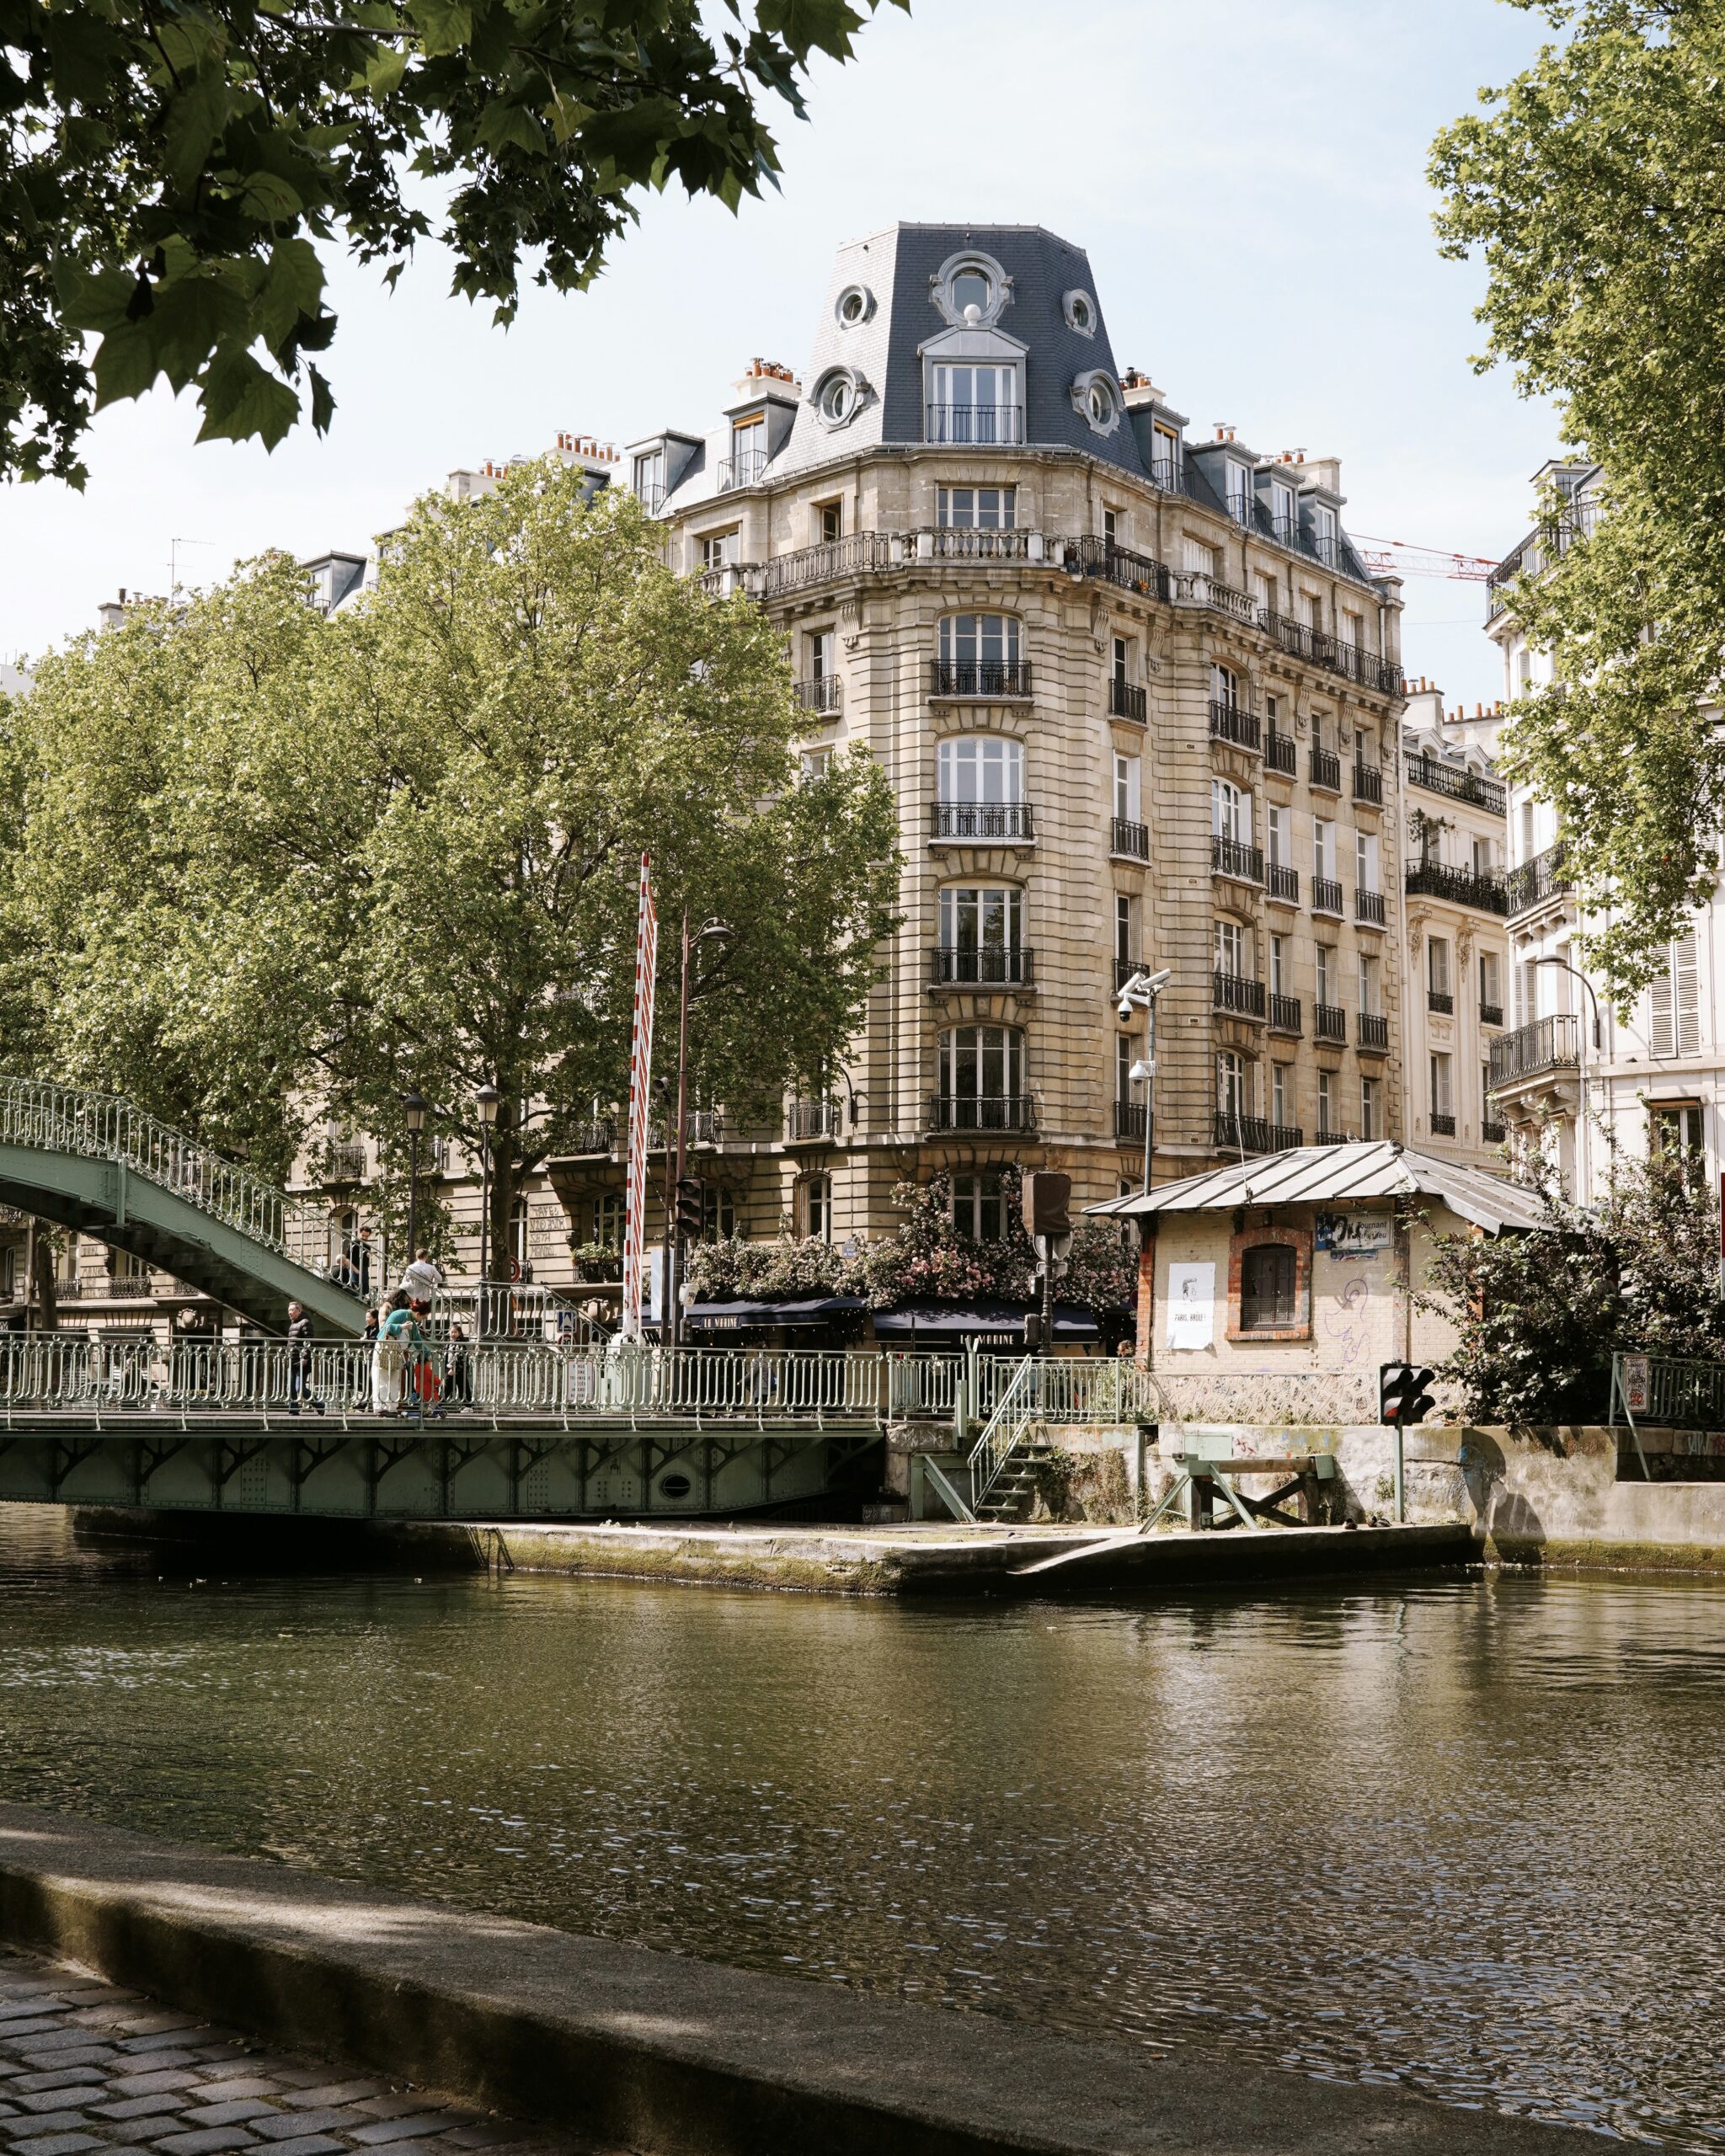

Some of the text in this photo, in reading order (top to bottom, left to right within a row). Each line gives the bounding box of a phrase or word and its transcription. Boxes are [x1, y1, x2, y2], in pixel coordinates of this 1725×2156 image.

[704, 1317, 739, 1328] LA MARINE
[977, 1334, 1014, 1345] MARINE
